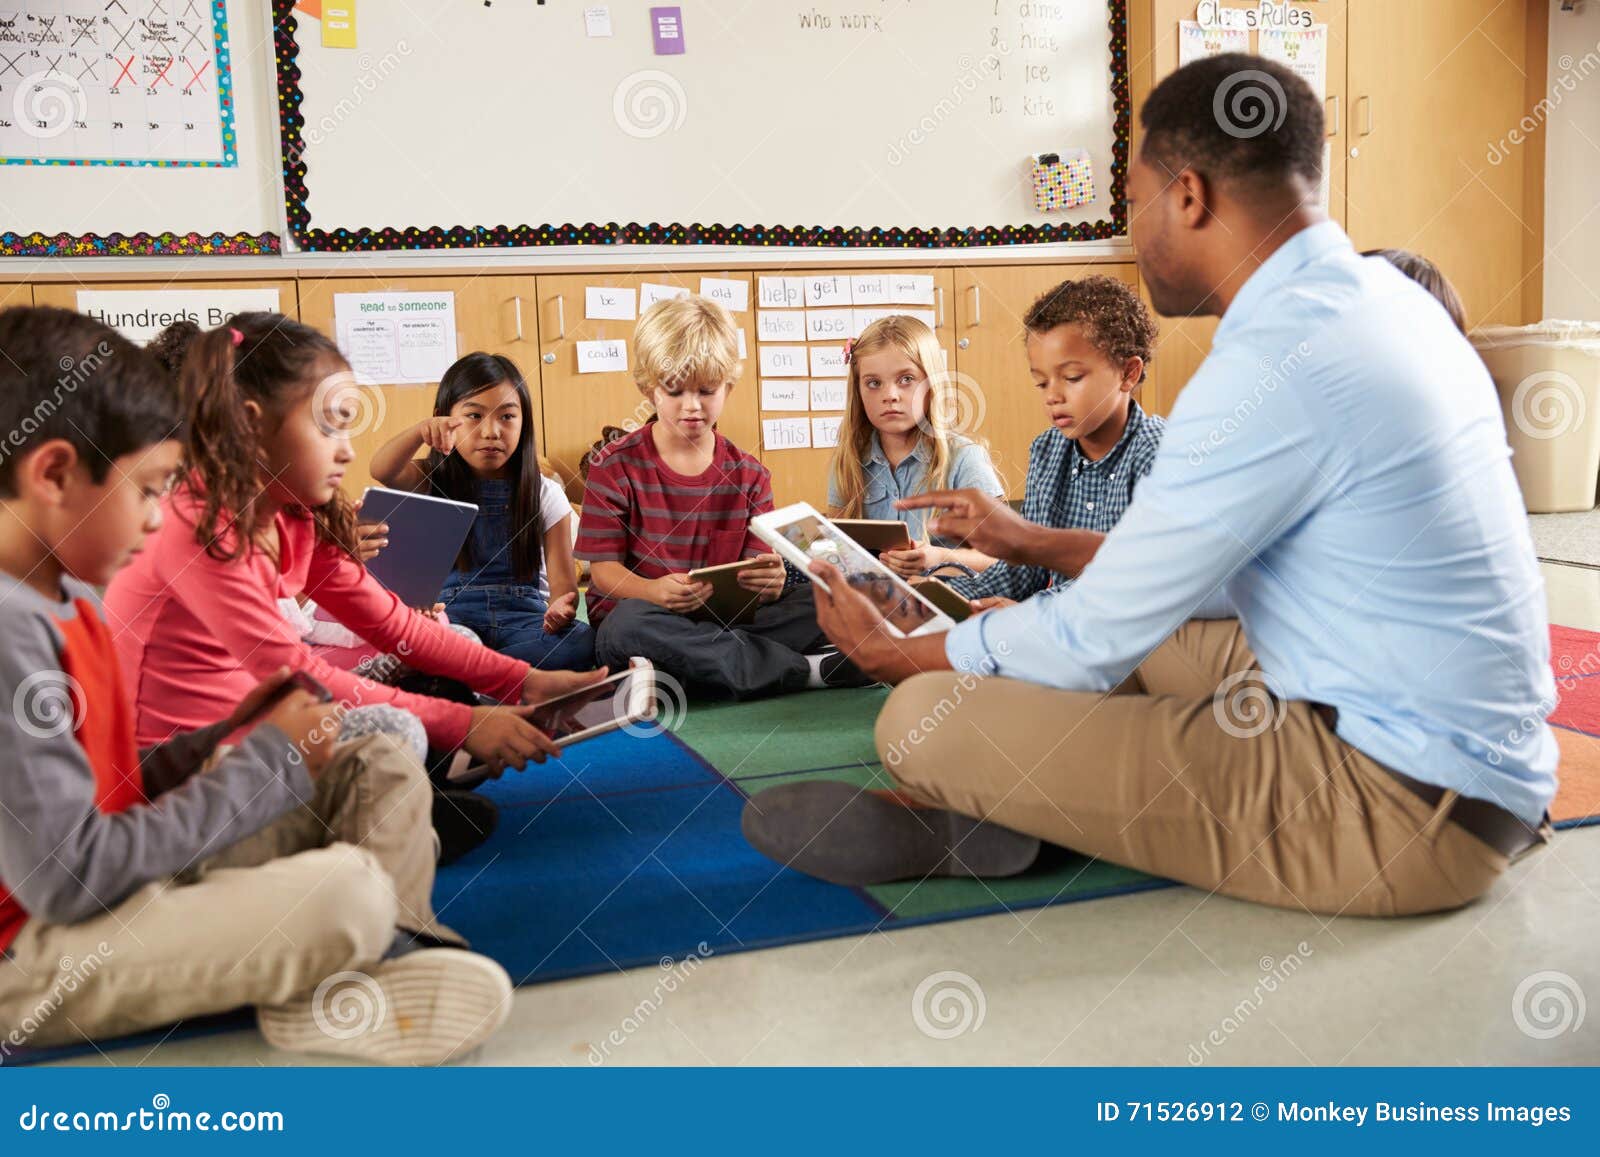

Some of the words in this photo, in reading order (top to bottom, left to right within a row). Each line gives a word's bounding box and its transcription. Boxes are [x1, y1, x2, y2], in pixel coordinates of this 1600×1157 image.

[799, 8, 831, 29] who
[1200, 1, 1257, 27] Clas
[1261, 1, 1313, 27] Rules
[711, 287, 732, 299] old
[762, 279, 798, 307] help
[813, 276, 839, 299] get
[858, 279, 882, 294] and
[360, 302, 385, 313] Read
[398, 301, 447, 312] someone
[88, 308, 200, 328] Hundreds
[764, 316, 795, 334] take
[813, 319, 845, 333] use
[587, 347, 619, 359] could
[772, 353, 793, 367] on
[771, 421, 805, 445] this
